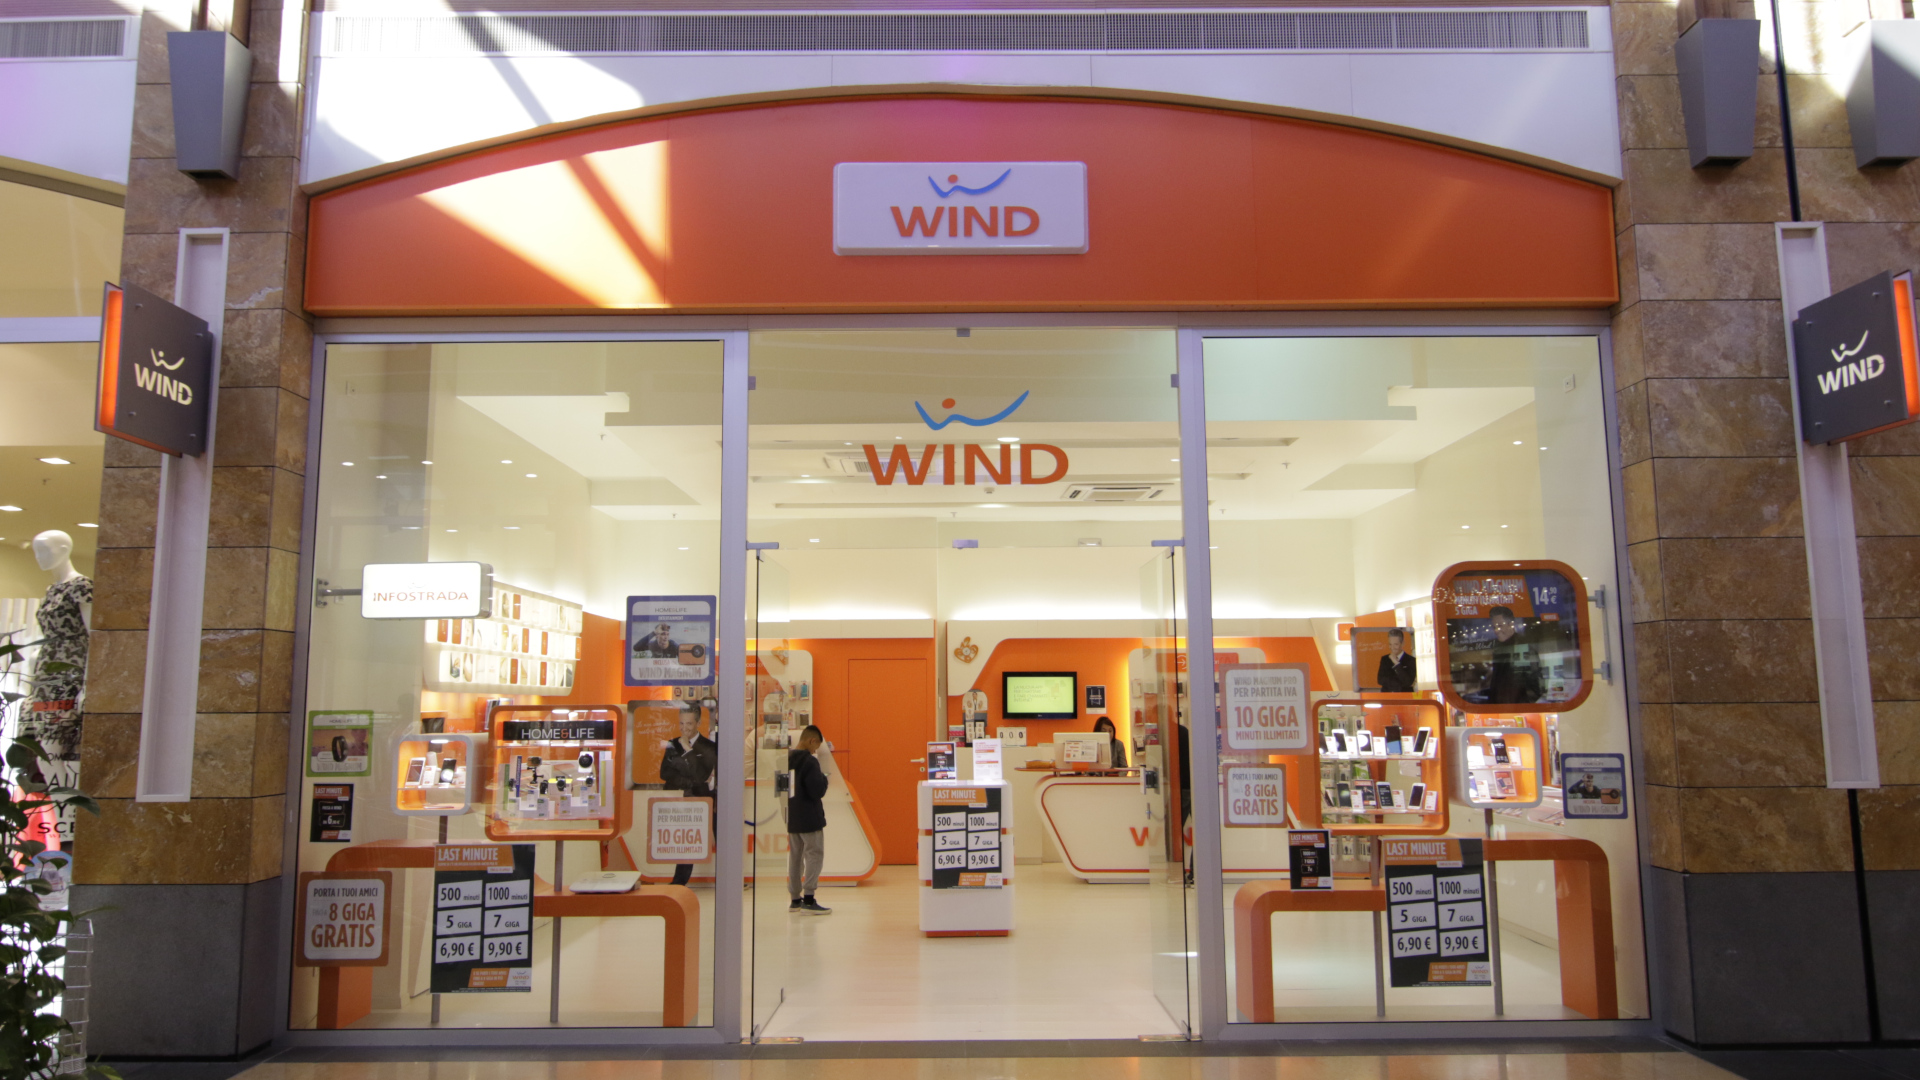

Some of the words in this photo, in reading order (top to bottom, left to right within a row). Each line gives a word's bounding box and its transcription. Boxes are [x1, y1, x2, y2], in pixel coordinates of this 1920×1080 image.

[890, 206, 1040, 237] WIND
[1816, 354, 1885, 395] WIND
[134, 363, 193, 406] WIND
[862, 444, 1068, 485] WIND
[372, 592, 468, 602] INFOSTRADA
[1461, 606, 1478, 615] GIGA
[639, 667, 662, 678] WIND
[664, 667, 702, 678] MAGNUM
[1234, 677, 1251, 686] WIND
[1234, 688, 1248, 697] PER
[1251, 687, 1282, 697] PARTITA
[1284, 686, 1297, 696] IVA
[1234, 706, 1254, 728] 10
[1258, 706, 1298, 727] GIGA
[522, 728, 595, 739] HOME&LIFE
[1236, 731, 1261, 740] MINUTI
[1263, 730, 1300, 740] ILLIMITATI
[934, 790, 950, 799] LAST
[951, 790, 976, 799] MINUTE
[1245, 784, 1250, 796] 8
[1254, 784, 1278, 797] GIGA
[1233, 799, 1278, 816] GRATIS
[658, 815, 668, 823] PER
[670, 815, 692, 823] PARTITA
[937, 817, 951, 826] 500
[970, 817, 985, 826] 1000
[657, 829, 671, 844] 10
[673, 829, 702, 844] GIGA
[941, 836, 946, 845] 5
[974, 836, 980, 845] 7
[438, 848, 459, 861] LAST
[462, 847, 498, 861] MINUTE
[676, 846, 702, 854] ILLIMITATI
[1387, 843, 1408, 855] LAST
[1410, 842, 1446, 855] MINUTE
[938, 855, 955, 866] 6,90
[957, 855, 962, 864] €
[971, 855, 988, 866] 9,90
[990, 855, 995, 864] €
[314, 888, 335, 897] PORTA
[337, 888, 340, 897] I
[342, 888, 357, 897] TUOI
[359, 888, 378, 897] AMICI
[488, 887, 510, 900] 1000
[1393, 882, 1412, 895] 500
[1440, 881, 1461, 894] 1000
[440, 888, 461, 901] 500
[463, 893, 480, 901] minuti
[329, 903, 338, 921] 8
[342, 903, 376, 921] GIGA
[1400, 909, 1408, 922] 5
[1448, 909, 1455, 922] 7
[446, 915, 454, 928] 5
[493, 914, 502, 928] 7
[311, 924, 375, 948] GRATIS
[440, 942, 465, 958] 6,90
[468, 942, 474, 956] €
[488, 942, 512, 958] 9,90
[516, 942, 522, 955] €
[1397, 937, 1421, 952] 6,90
[1425, 937, 1431, 950] €
[1445, 936, 1469, 952] 9,90
[1472, 936, 1478, 949] €
